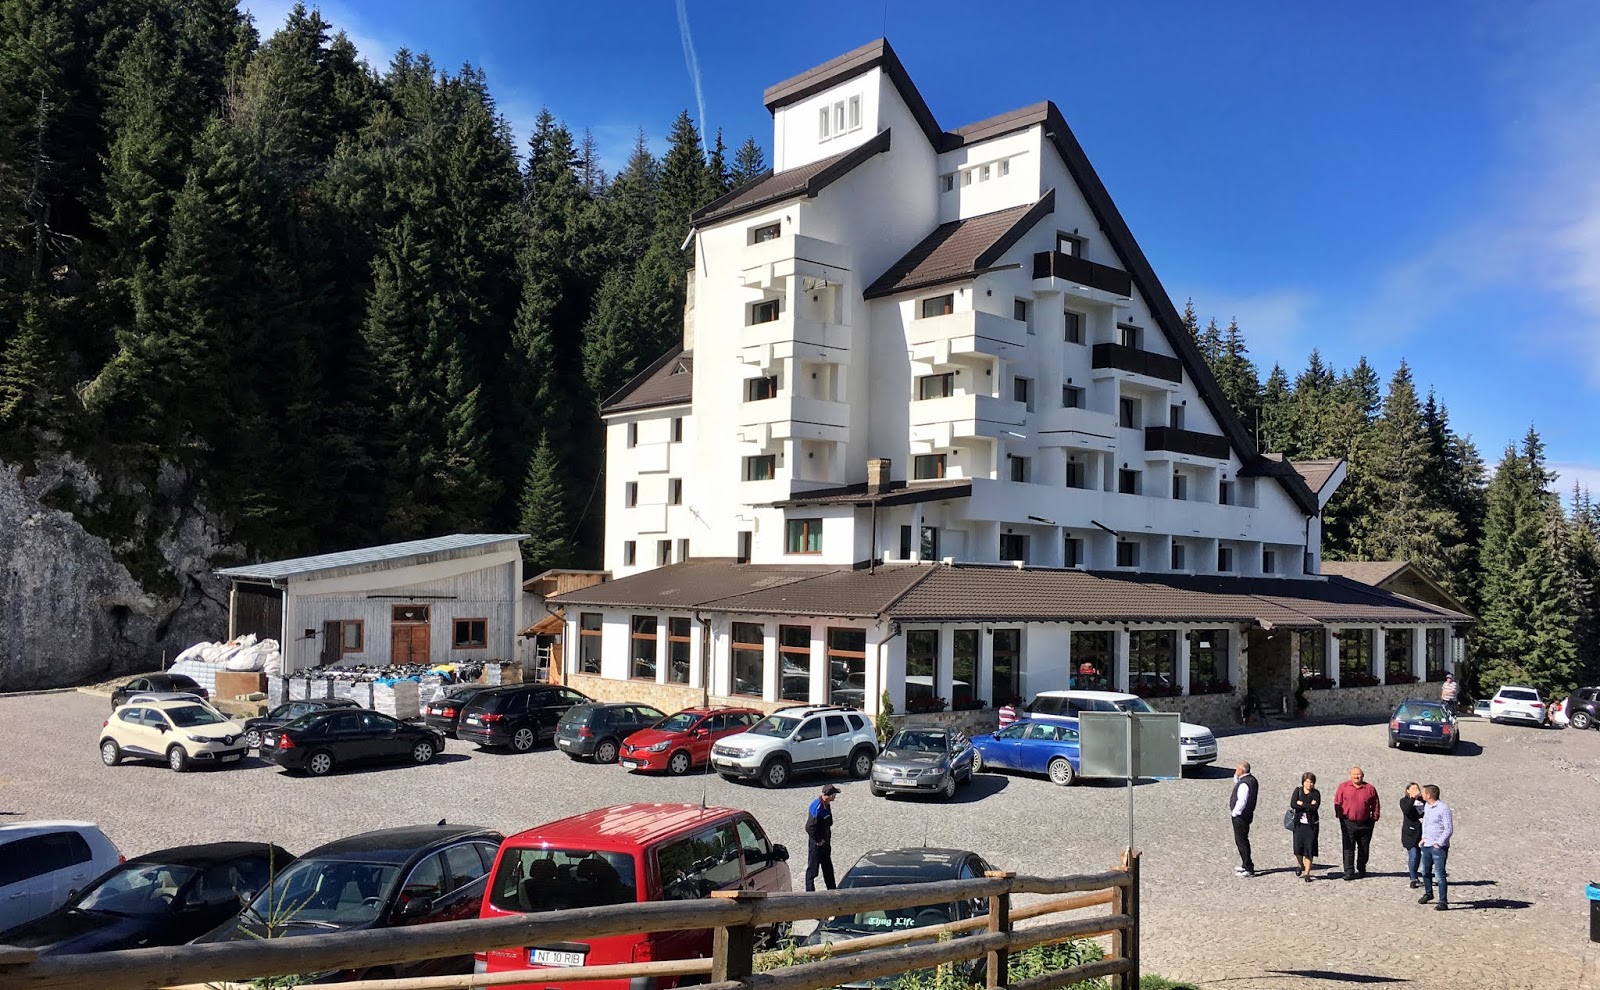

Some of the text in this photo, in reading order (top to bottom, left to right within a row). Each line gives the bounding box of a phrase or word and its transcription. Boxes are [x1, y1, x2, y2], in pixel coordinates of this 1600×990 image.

[868, 917, 915, 928] Thug Life
[538, 951, 580, 964] NT 10 RIB
